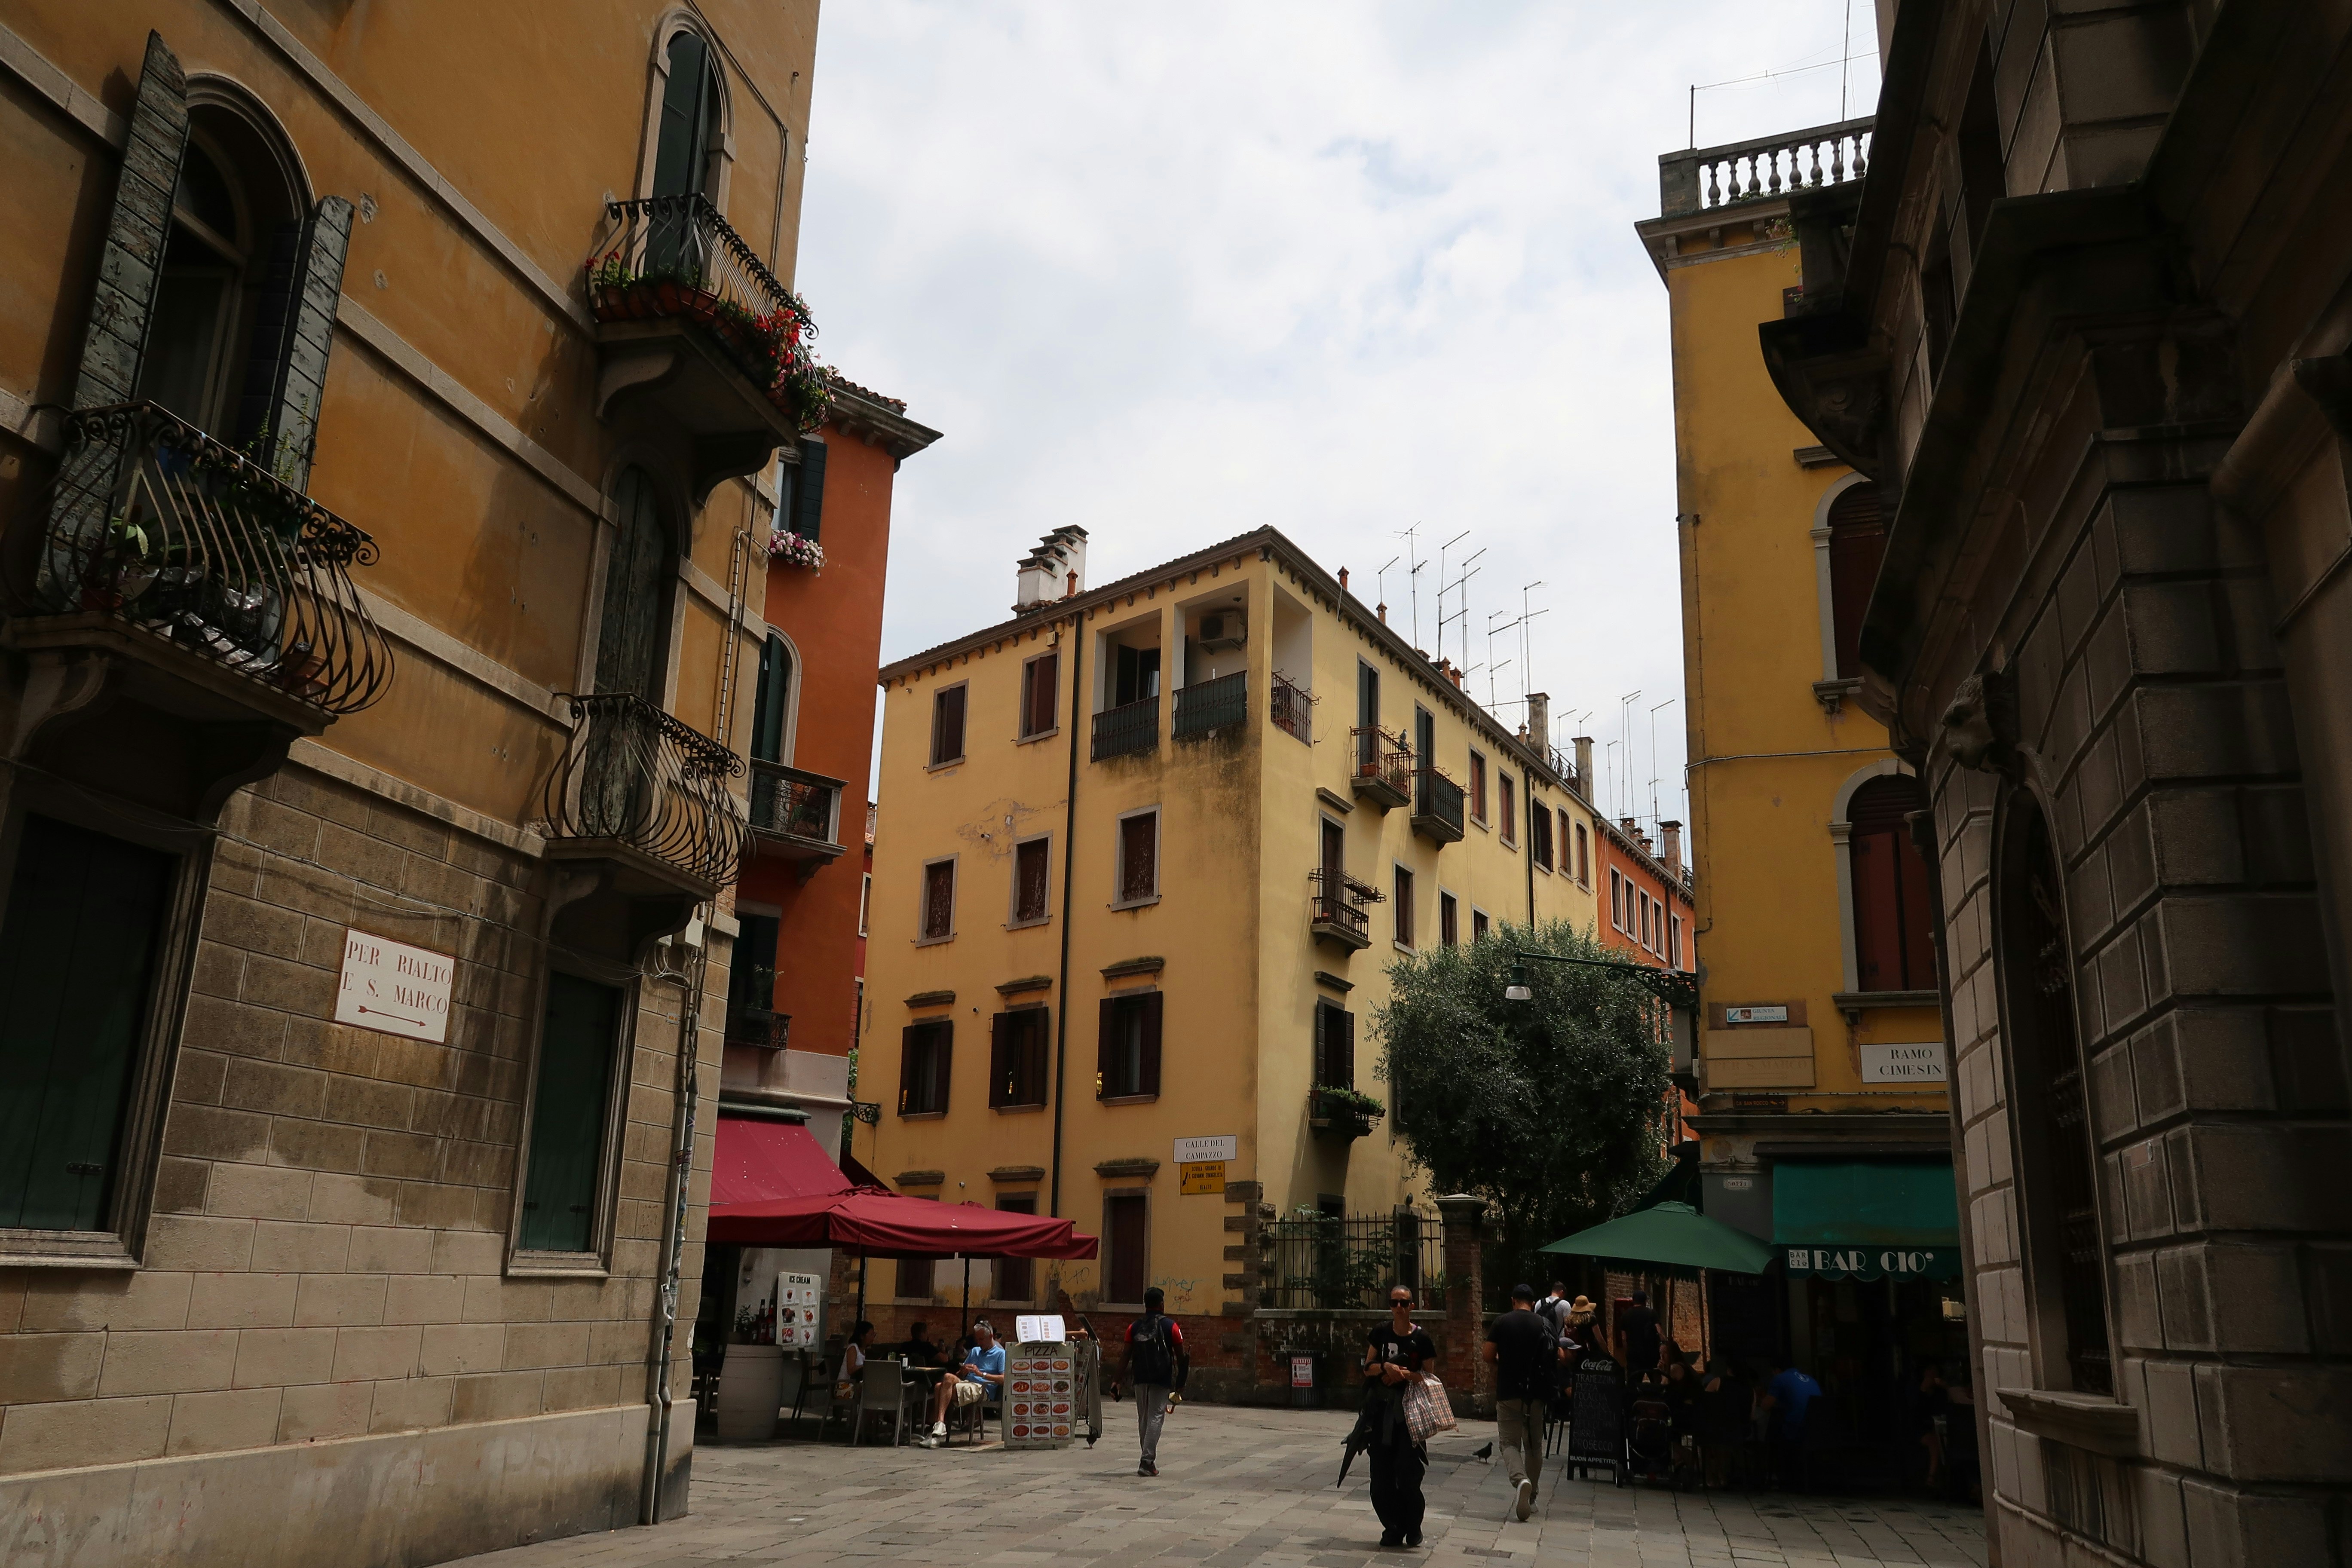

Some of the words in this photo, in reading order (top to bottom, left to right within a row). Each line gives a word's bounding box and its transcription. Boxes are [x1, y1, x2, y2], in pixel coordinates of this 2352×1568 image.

[348, 940, 380, 966] PER
[397, 954, 452, 986] RIALTO
[343, 971, 355, 991] E
[366, 977, 379, 998] S.
[393, 984, 448, 1014] MARCO
[1890, 1048, 1932, 1060] RAMO
[1879, 1064, 1942, 1076] CIMESIN
[1185, 1140, 1209, 1148] CALLE
[1210, 1139, 1224, 1147] DEL
[1185, 1151, 1222, 1160] CAMPAZZO
[1813, 1250, 1866, 1271] BAR
[1025, 1346, 1058, 1357] PIZZA
[1575, 1374, 1616, 1385] TRAMEZZINI
[1576, 1382, 1598, 1392] PIZZA
[1574, 1391, 1608, 1402] FOCACCIA
[1573, 1429, 1596, 1438] BIRRA
[1572, 1438, 1613, 1451] PROSECCO
